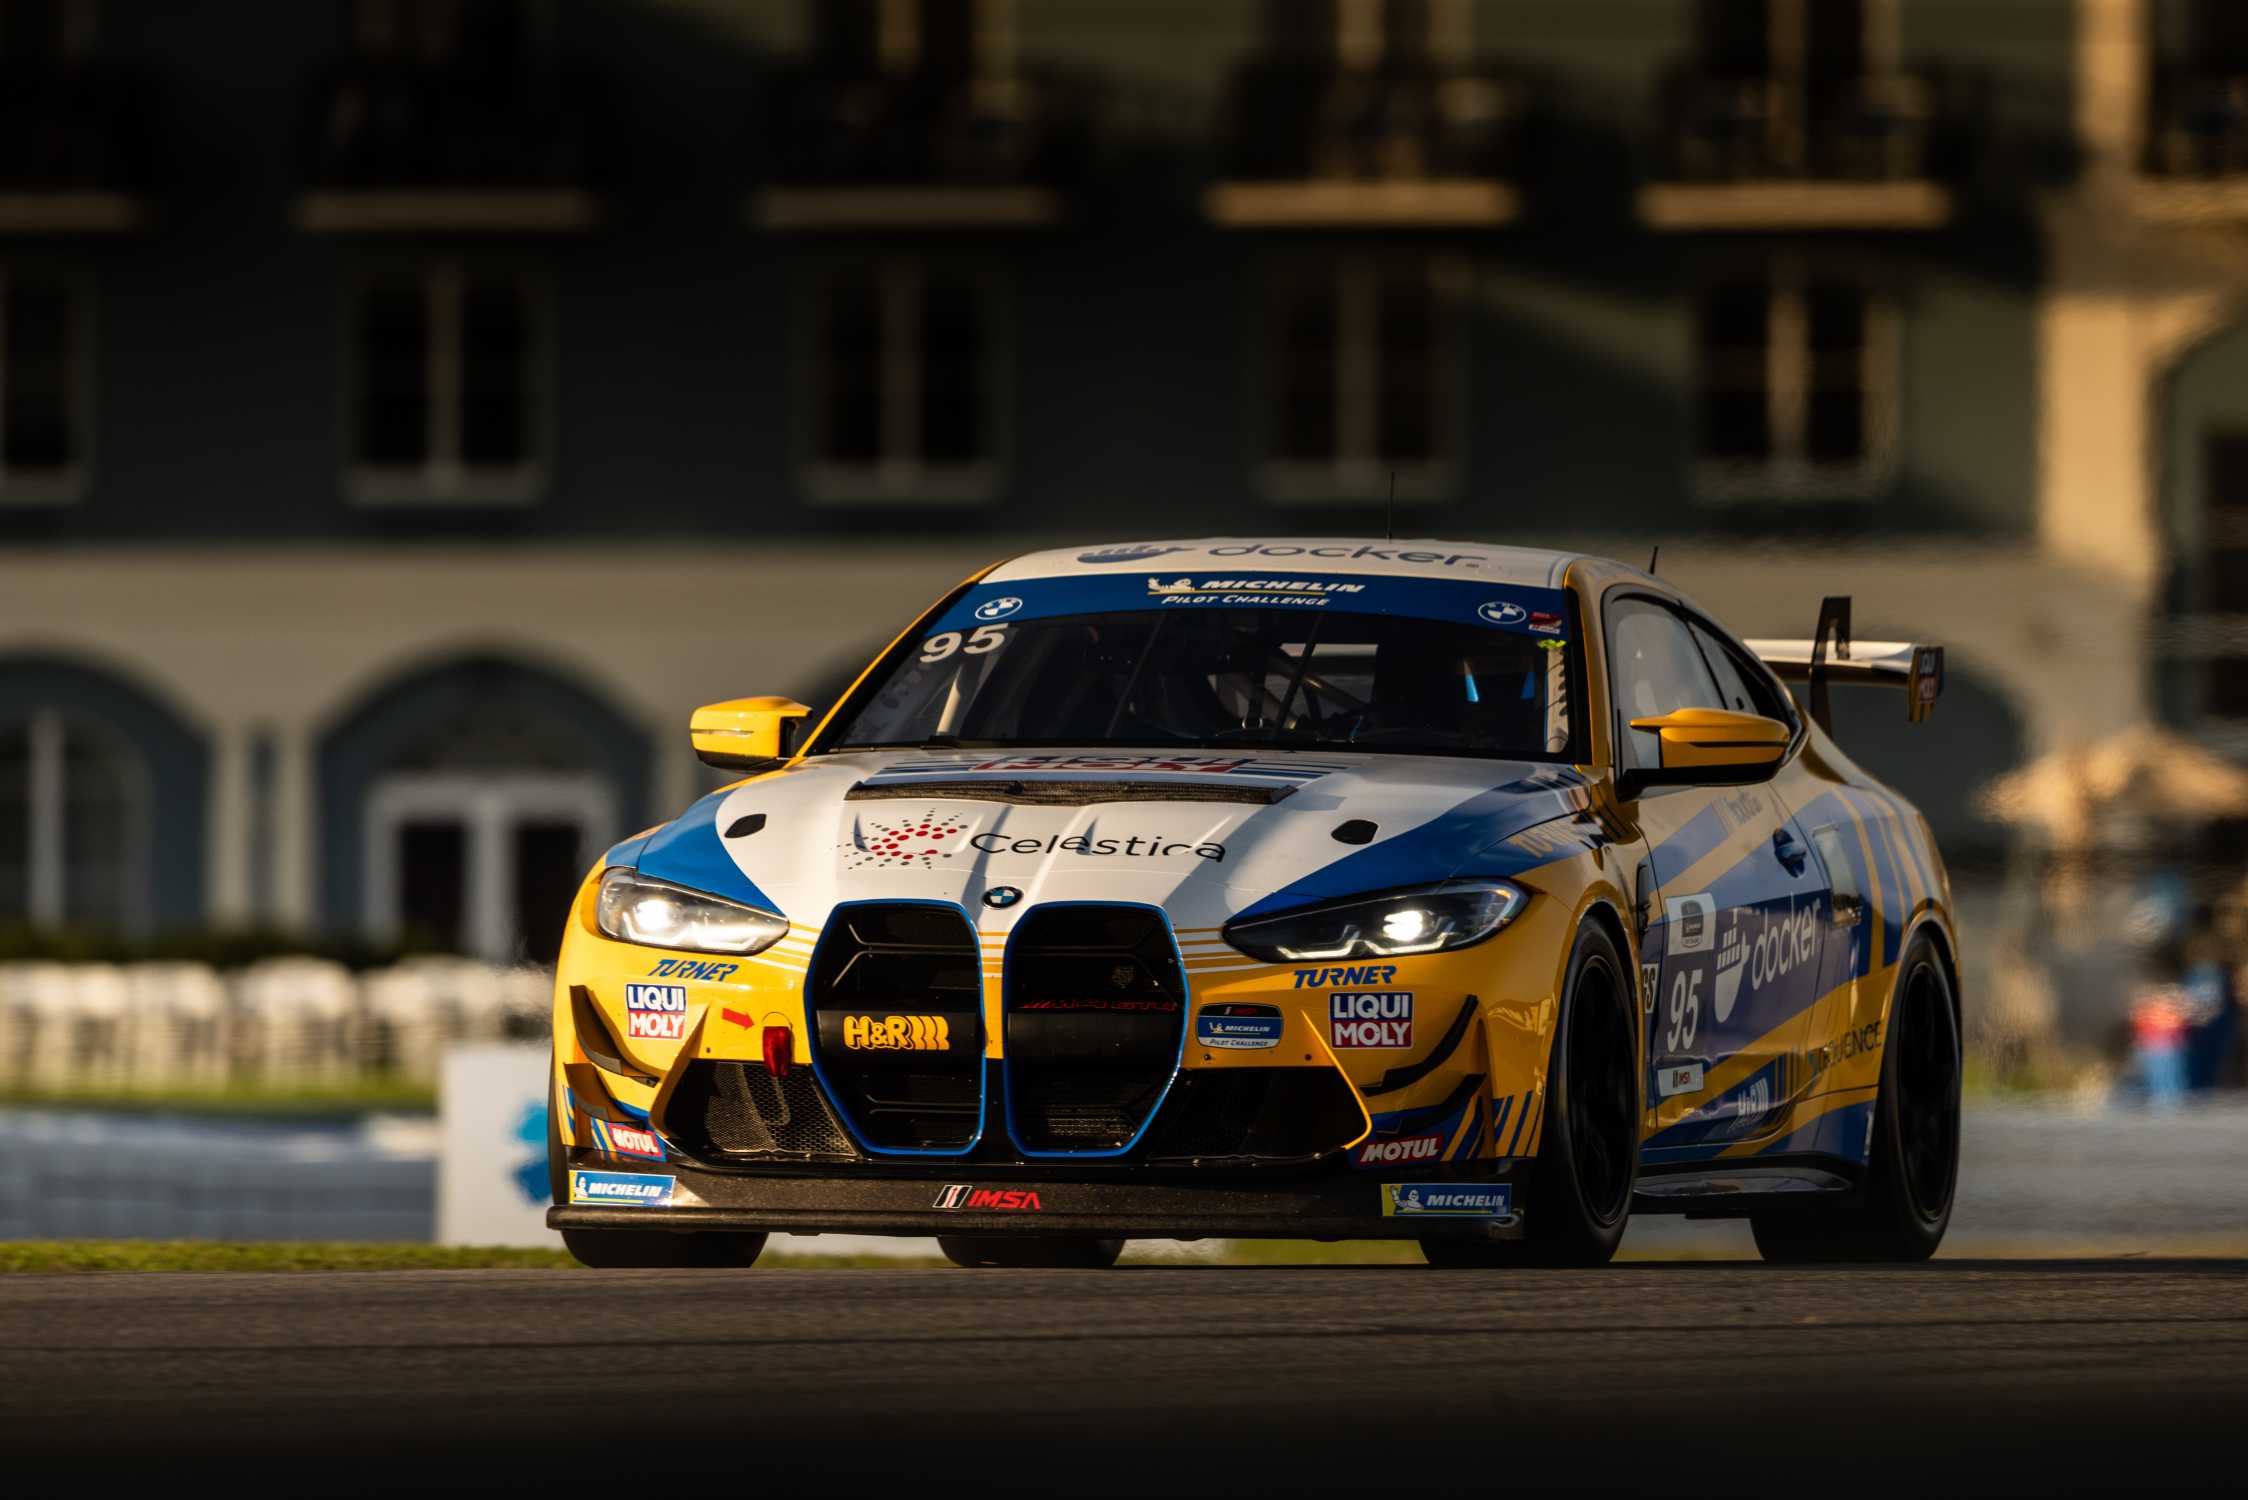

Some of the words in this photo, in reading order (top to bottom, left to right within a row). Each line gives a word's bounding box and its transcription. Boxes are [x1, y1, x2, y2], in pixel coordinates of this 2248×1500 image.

[1208, 544, 1487, 566] docker
[1200, 580, 1366, 593] MICHELIN
[1161, 594, 1219, 605] PILOT
[1222, 594, 1331, 606] CHALLENGE
[920, 622, 1009, 663] 95
[970, 832, 1227, 864] Celestica
[1752, 891, 1821, 991] docker
[647, 959, 739, 982] TURNER
[1294, 965, 1397, 989] TURNER
[627, 985, 685, 1011] LIQUI
[1333, 994, 1410, 1020] LIQUI
[1667, 968, 1703, 1053] 95
[630, 1011, 685, 1038] MOLY
[843, 1015, 914, 1050] H&R
[1334, 1021, 1411, 1047] MOLY
[611, 1127, 660, 1153] MOTUL
[1360, 1138, 1439, 1162] MOTUL
[588, 1181, 663, 1197] MICHELIN
[967, 1189, 1041, 1211] IMSA
[1427, 1194, 1505, 1207] MICHELIN
